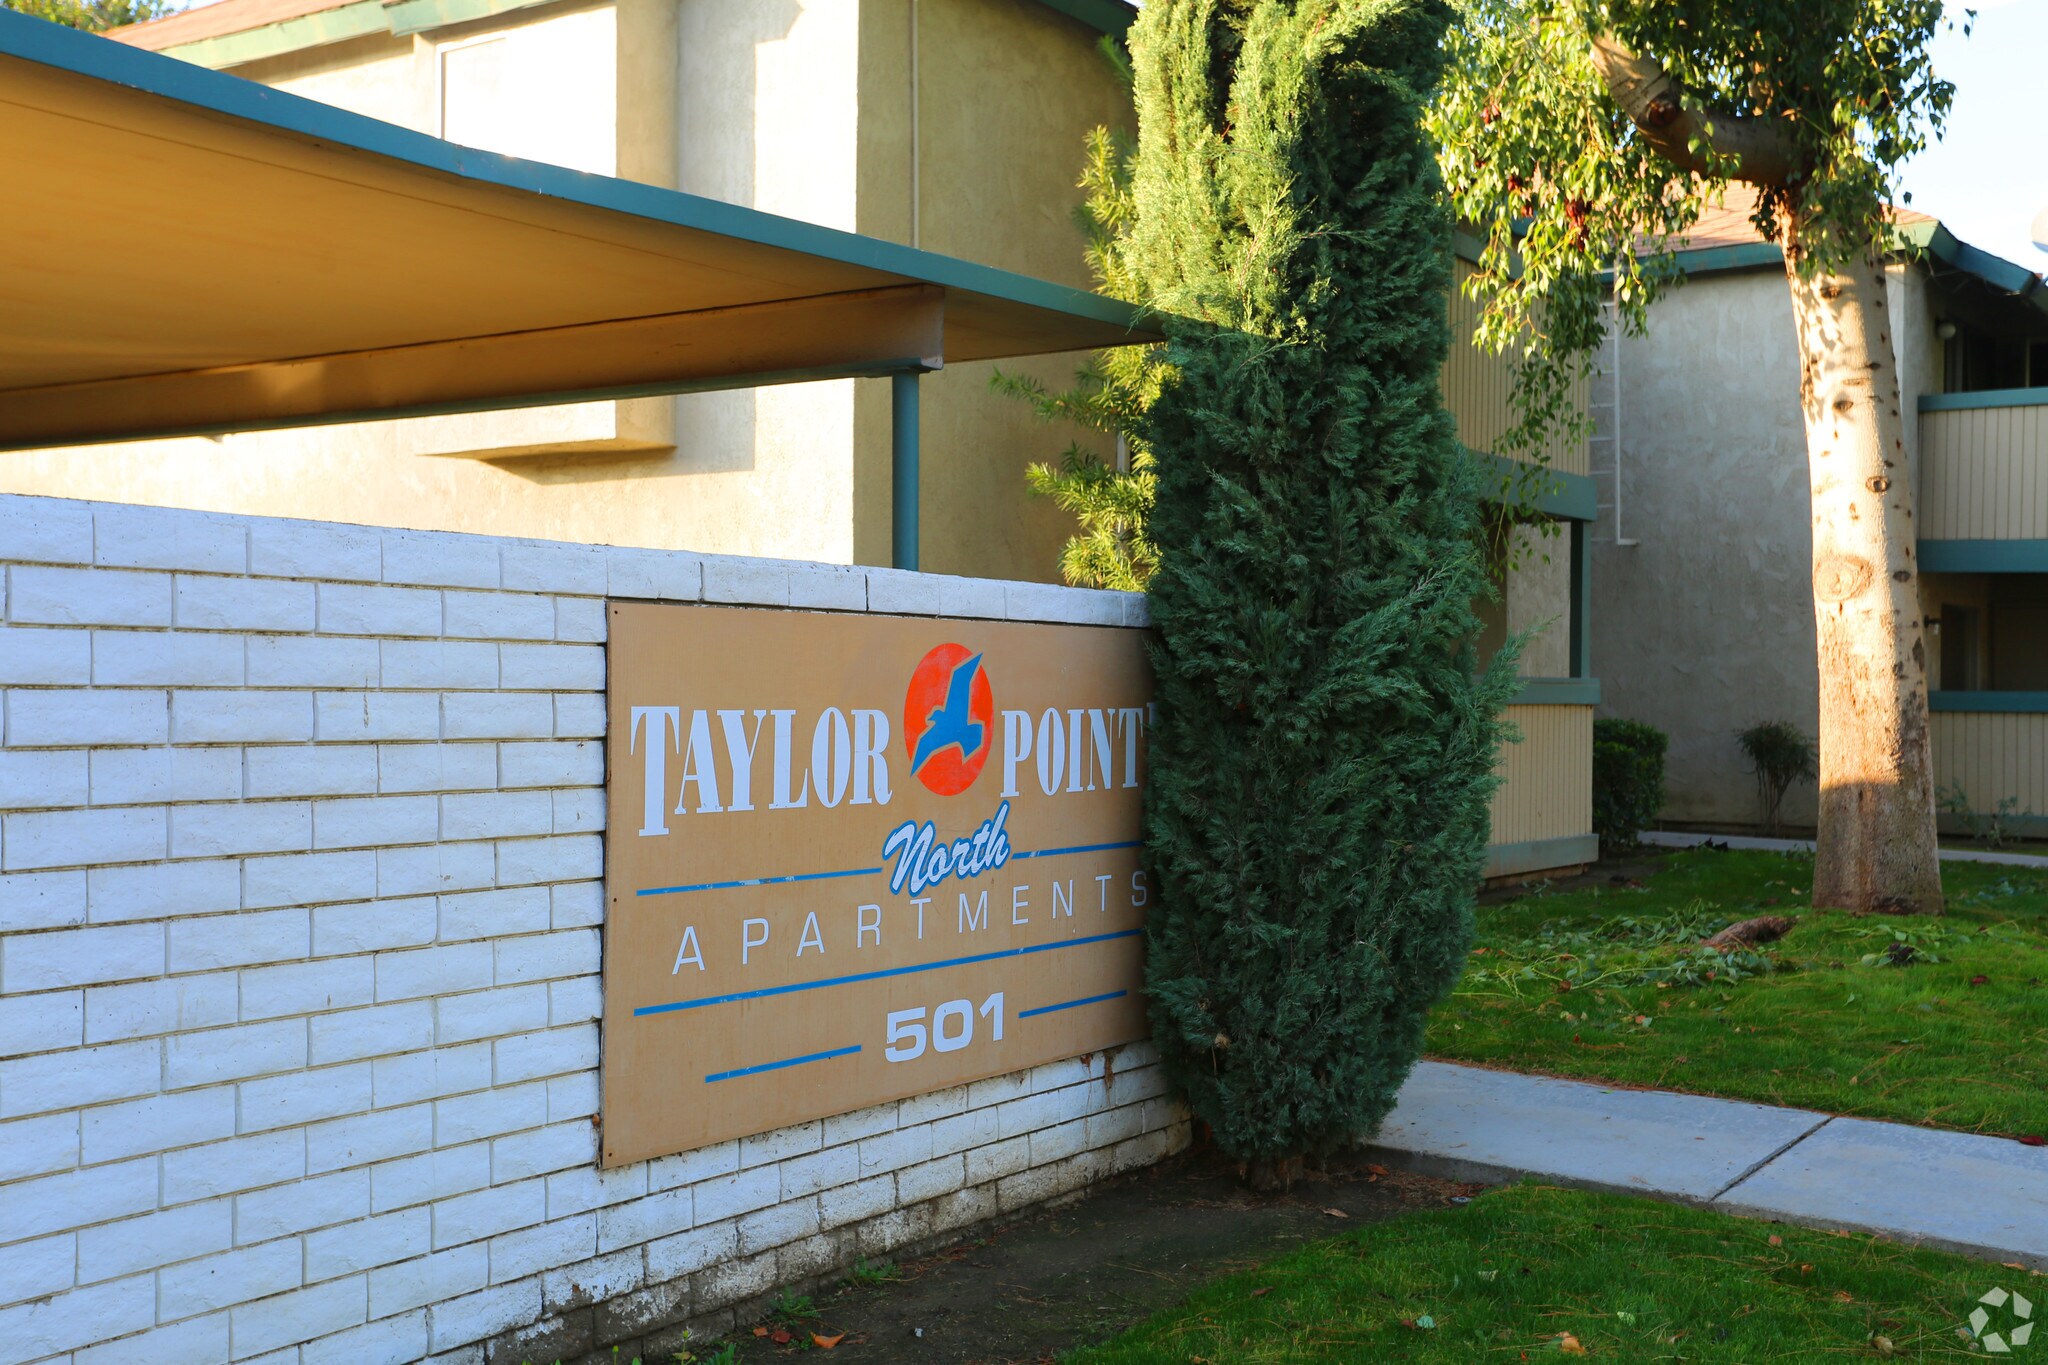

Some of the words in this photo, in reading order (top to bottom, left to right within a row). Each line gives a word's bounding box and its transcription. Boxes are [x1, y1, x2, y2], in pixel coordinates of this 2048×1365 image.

[630, 705, 892, 837] TAYLOR
[1000, 702, 1156, 798] POINT
[883, 801, 1010, 896] North
[672, 870, 1148, 975] APARTMENTS
[885, 991, 1004, 1062] 501
